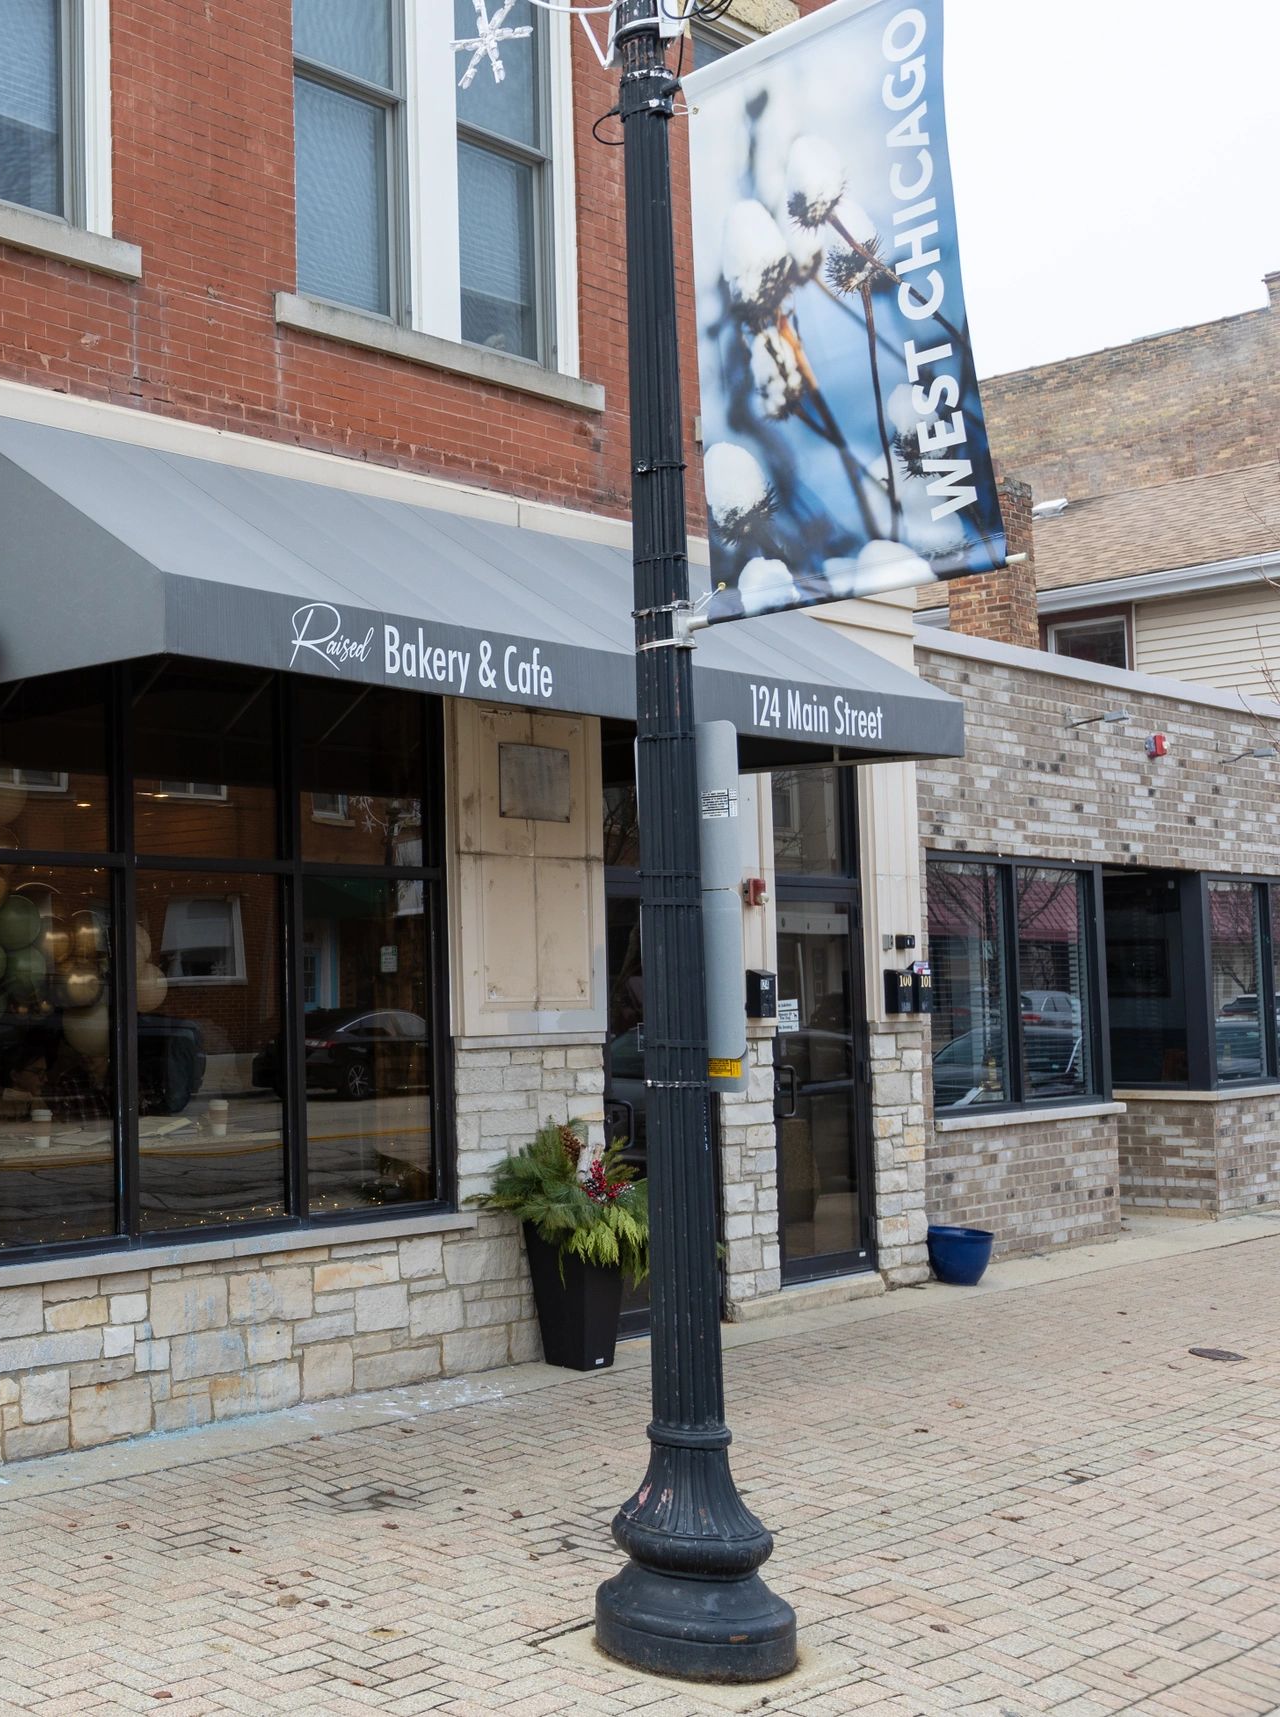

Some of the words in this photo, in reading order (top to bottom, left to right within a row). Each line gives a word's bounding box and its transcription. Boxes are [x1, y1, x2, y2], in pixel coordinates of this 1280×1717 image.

[881, 8, 945, 321] CHICAGO
[903, 339, 978, 522] WEST
[289, 603, 374, 672] Raised
[384, 624, 470, 694] Bakery
[478, 640, 497, 689] &
[503, 645, 553, 698] Cafe
[750, 684, 781, 728] 124
[787, 689, 829, 733] Main
[834, 695, 883, 740] Street
[899, 975, 913, 988] 100
[920, 975, 932, 988] 101
